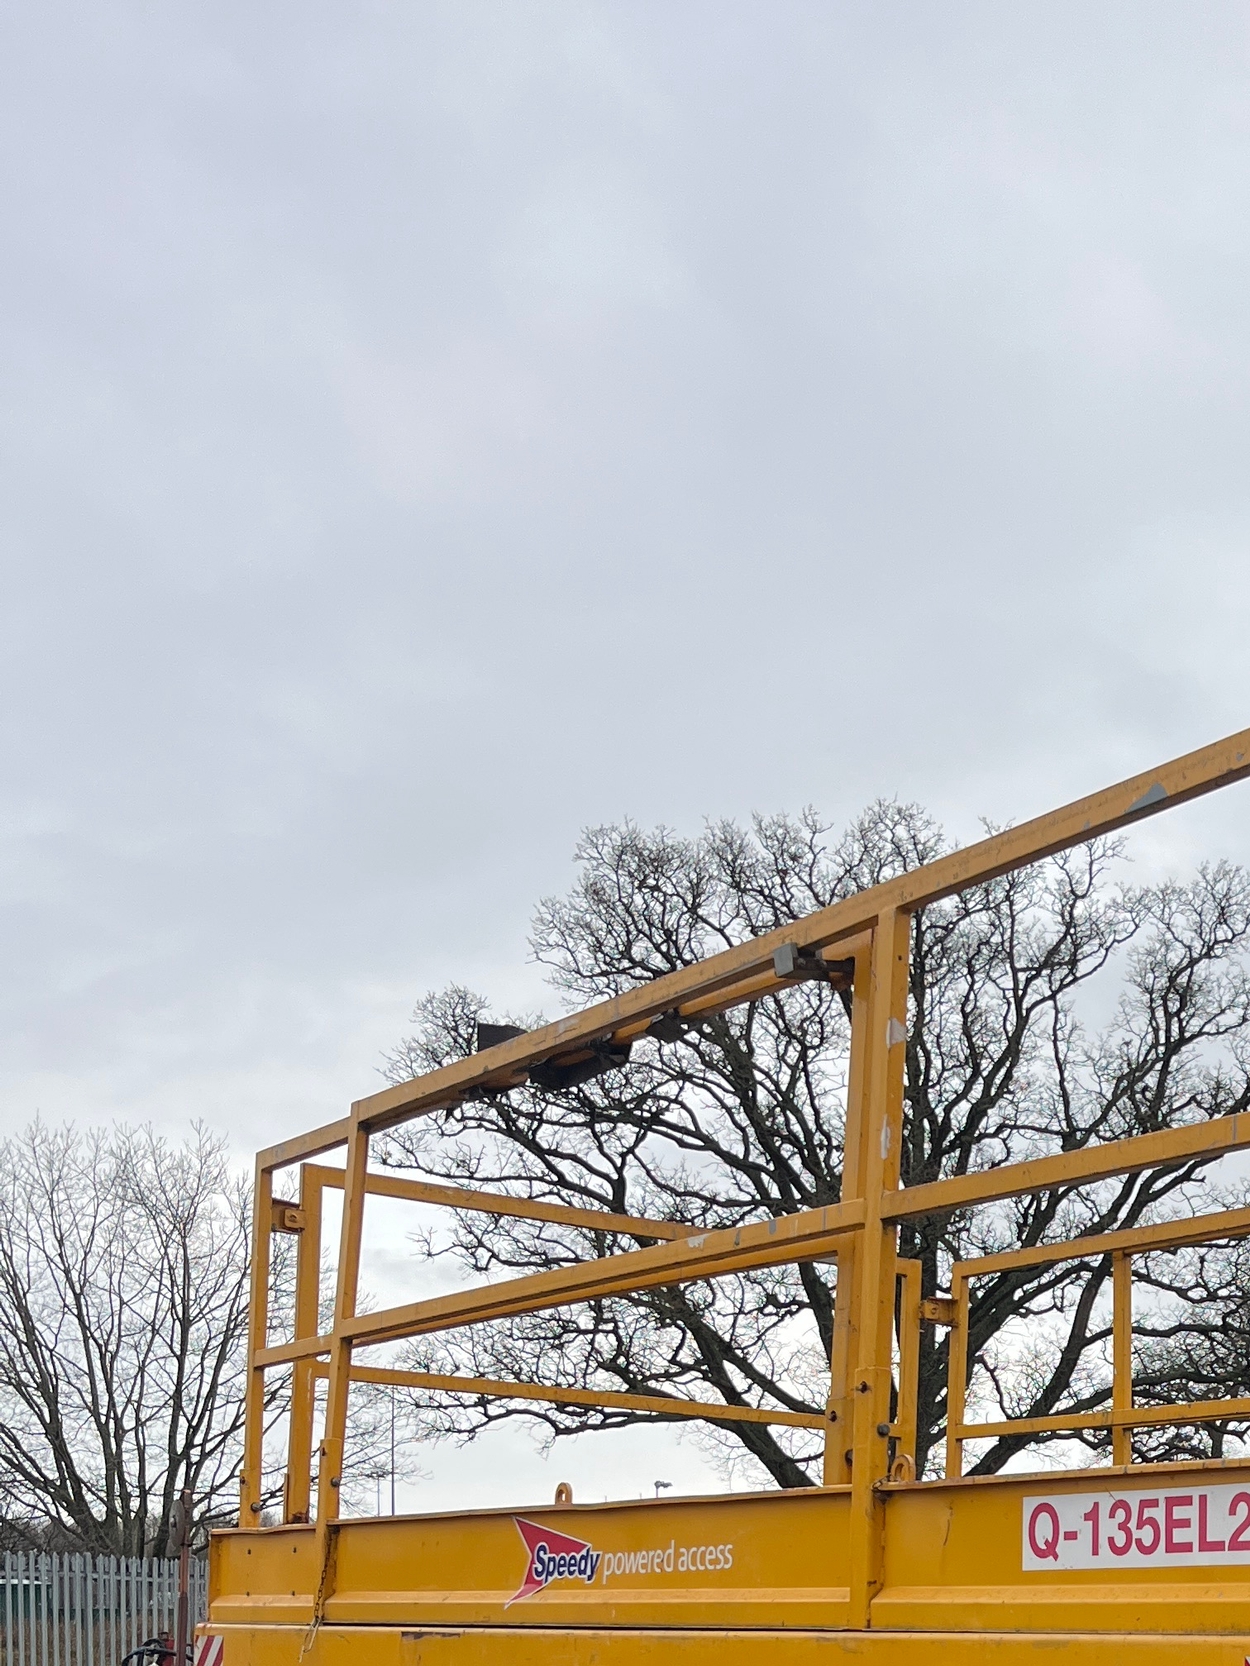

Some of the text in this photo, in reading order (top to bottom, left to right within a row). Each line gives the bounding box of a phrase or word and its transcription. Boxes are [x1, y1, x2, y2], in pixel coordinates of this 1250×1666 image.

[533, 1540, 734, 1585] Speedy powered access
